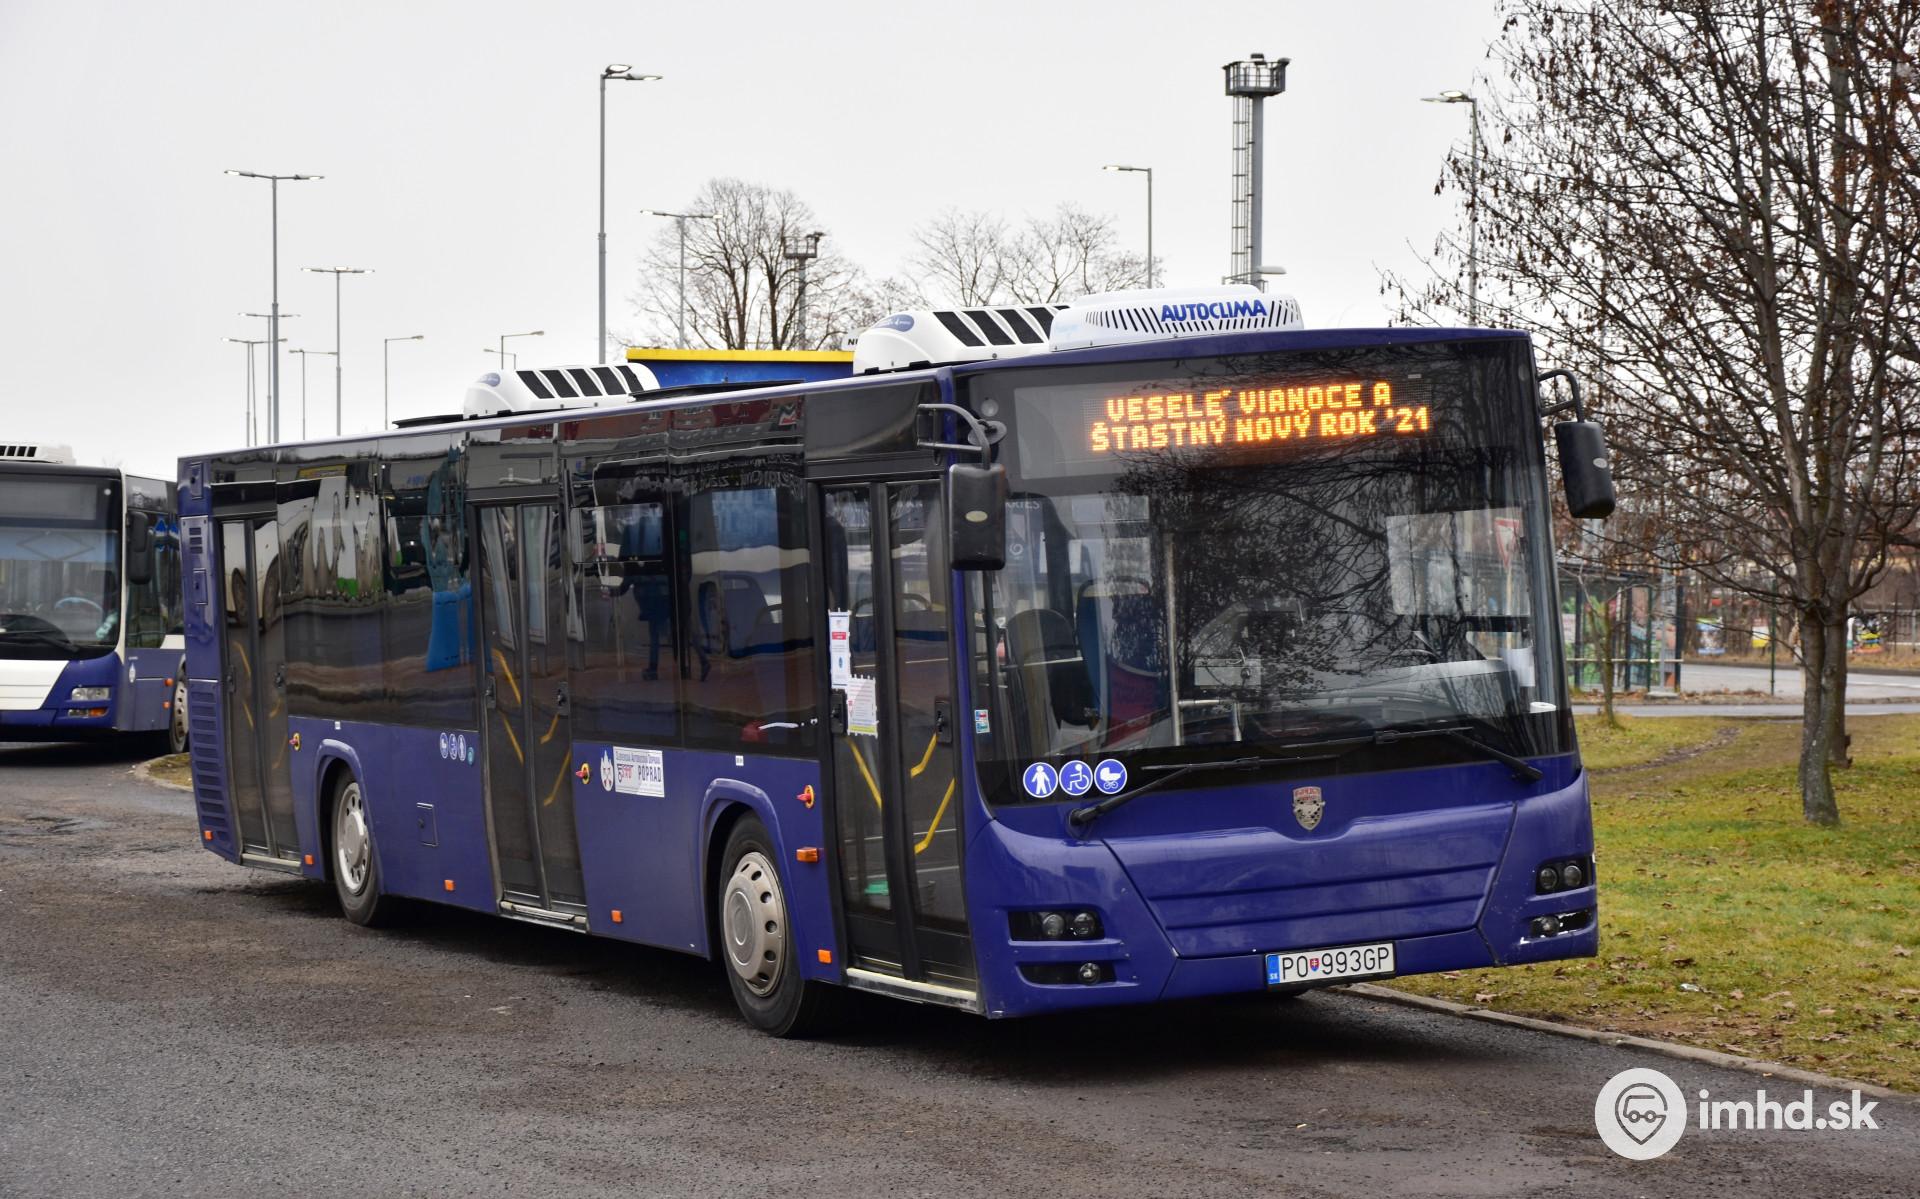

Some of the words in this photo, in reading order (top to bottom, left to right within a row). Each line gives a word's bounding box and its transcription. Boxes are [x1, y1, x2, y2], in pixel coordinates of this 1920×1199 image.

[1161, 299, 1268, 322] AUTOCLIMA
[1107, 389, 1232, 422] VESELÉ
[1238, 383, 1363, 415] VIANOCE
[1373, 382, 1391, 406] A
[1235, 409, 1311, 442] NOVÝ
[1320, 410, 1376, 437] ROK
[1385, 406, 1428, 432] '21
[638, 765, 661, 782] POPRAD
